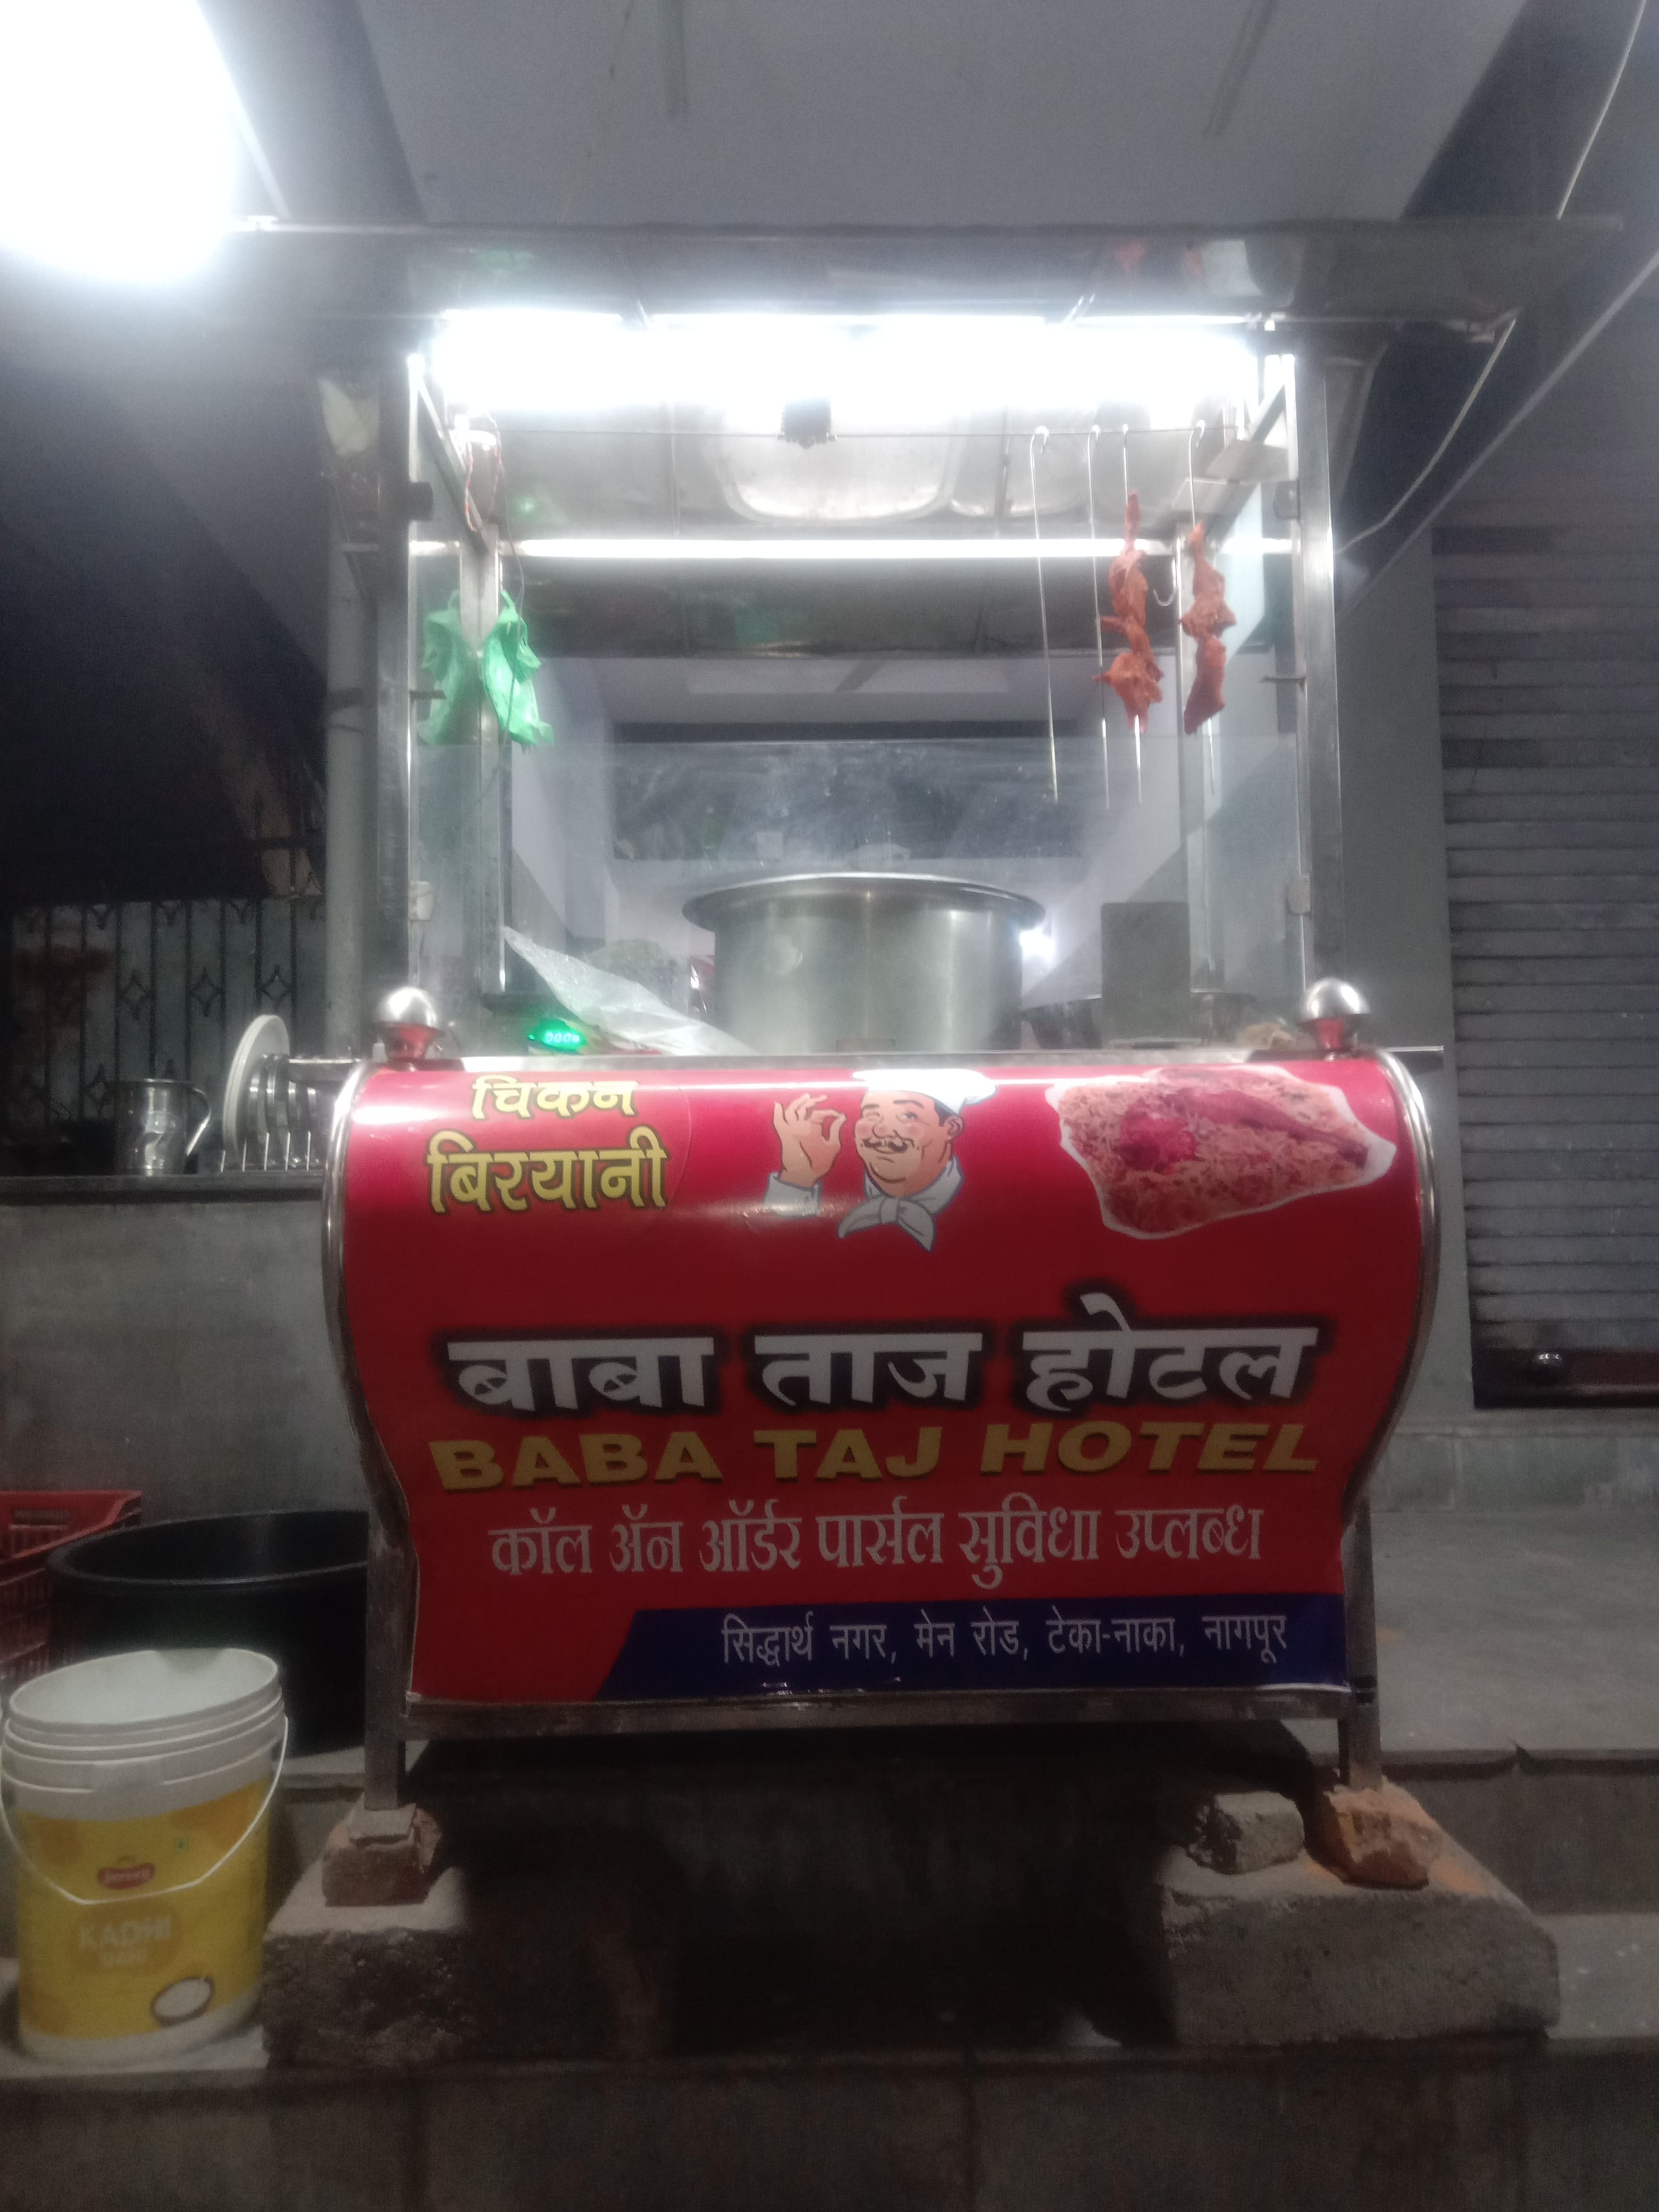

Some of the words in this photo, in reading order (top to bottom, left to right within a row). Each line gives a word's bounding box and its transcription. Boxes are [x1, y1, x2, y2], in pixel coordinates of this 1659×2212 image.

[472, 1074, 639, 1119] चिकन
[427, 1125, 668, 1213] बिरयानी
[447, 1336, 715, 1412] बाबा
[755, 1331, 983, 1407] ताज
[1022, 1292, 1319, 1412] होटल
[429, 1431, 723, 1490] BABA
[753, 1426, 943, 1480] TAJ
[981, 1421, 1319, 1475] HOTEL
[488, 1506, 593, 1575] कॉल
[699, 1498, 803, 1572] ऑर्डर
[815, 1495, 945, 1568] पार्सल
[958, 1492, 1102, 1589] सुविधा
[721, 1610, 814, 1667] सिद्धार्थ
[830, 1624, 896, 1665] नगर,
[914, 1607, 956, 1658] मेन
[970, 1605, 1028, 1661] रोड,
[1045, 1605, 1184, 1657] टेका-नाका,
[1201, 1614, 1287, 1664] नागपूर
